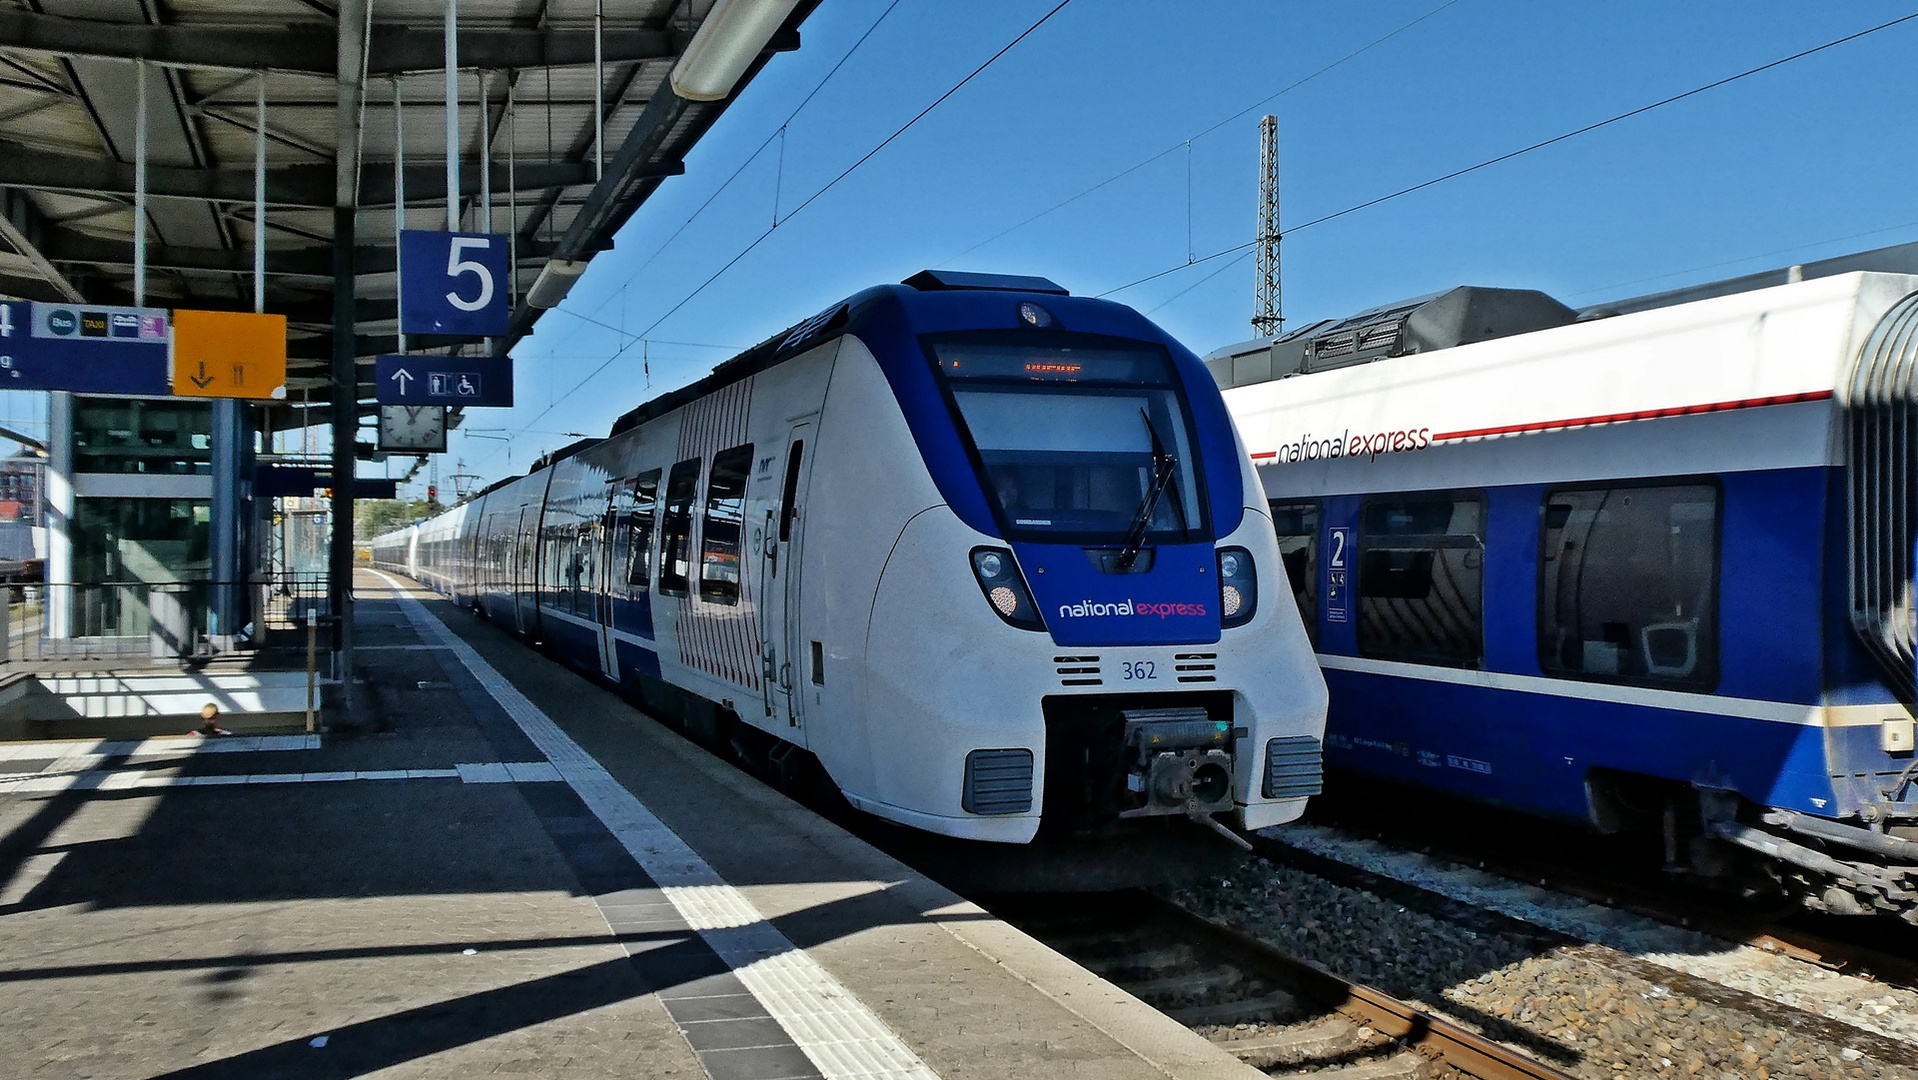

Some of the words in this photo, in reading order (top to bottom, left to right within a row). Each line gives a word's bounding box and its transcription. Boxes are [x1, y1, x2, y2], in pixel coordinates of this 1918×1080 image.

[446, 236, 494, 311] 5
[52, 317, 72, 328] Bus
[83, 319, 104, 329] TAXI
[1277, 429, 1348, 463] national
[1348, 427, 1429, 463] express
[1331, 530, 1345, 567] 2
[1059, 598, 1134, 618] national
[1136, 602, 1206, 619] express
[1122, 661, 1158, 680] 362
